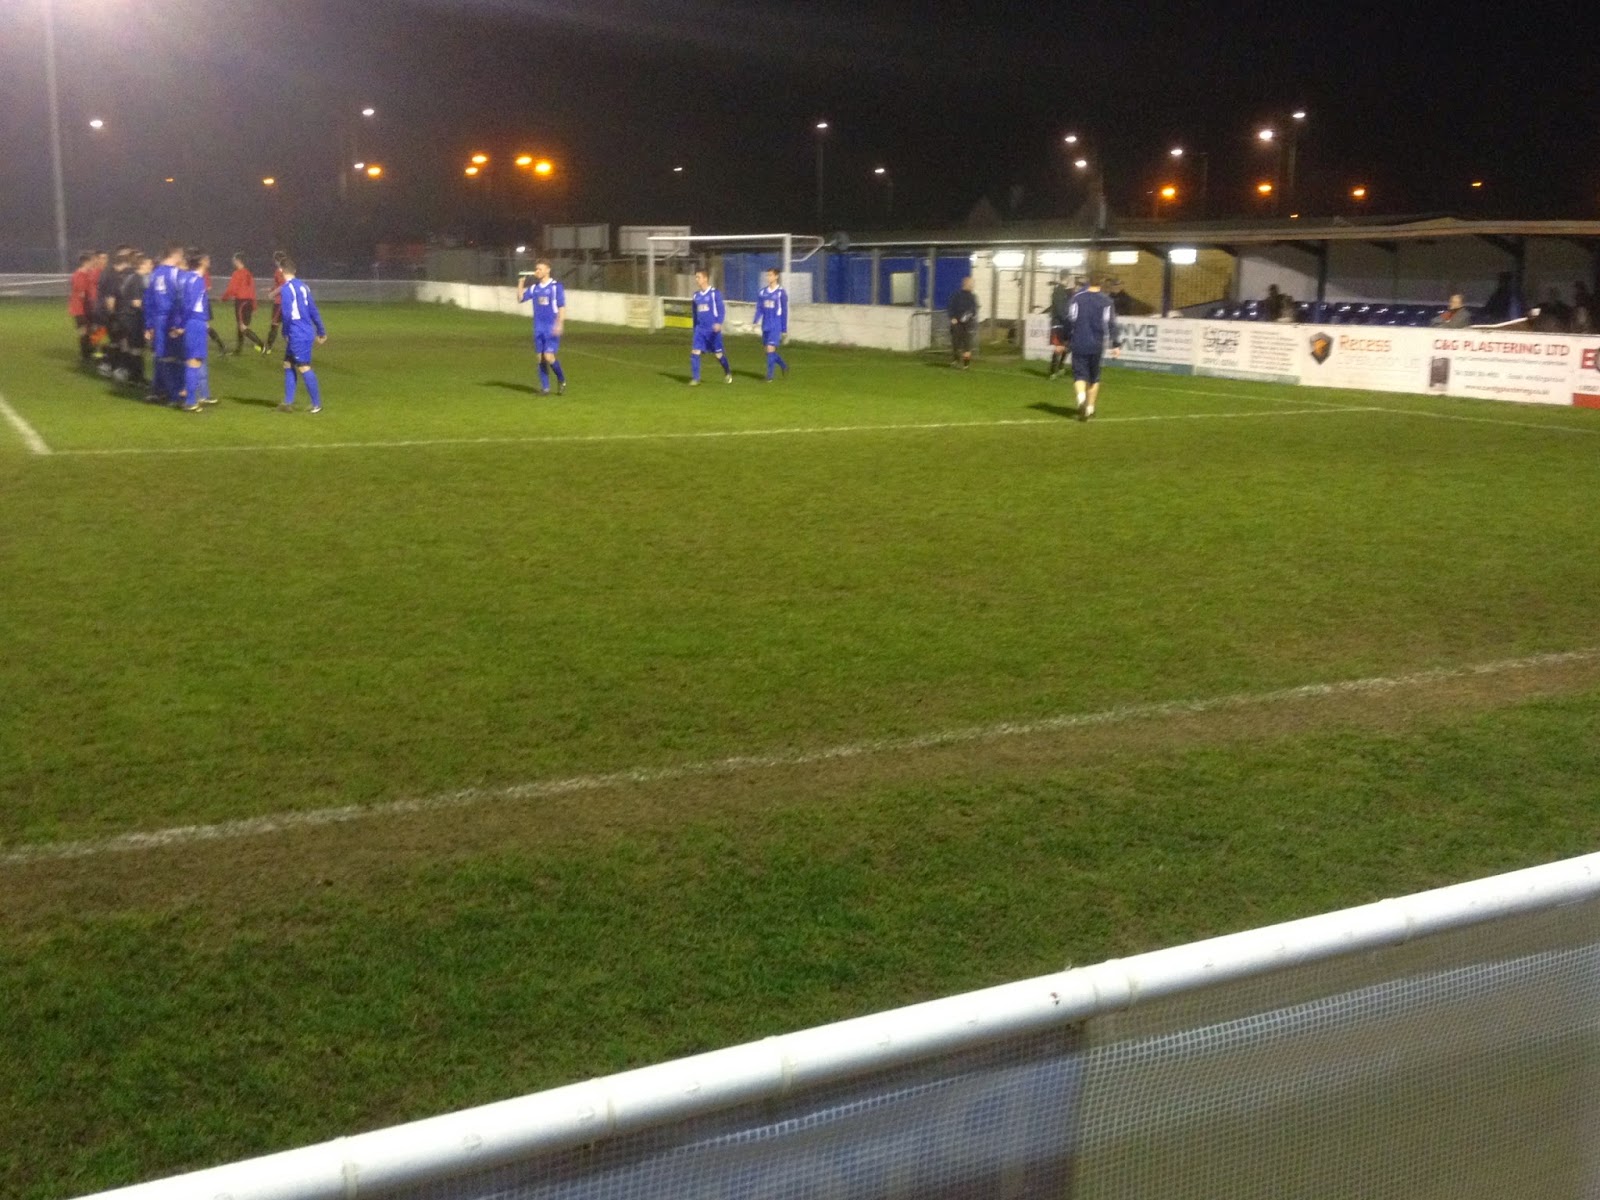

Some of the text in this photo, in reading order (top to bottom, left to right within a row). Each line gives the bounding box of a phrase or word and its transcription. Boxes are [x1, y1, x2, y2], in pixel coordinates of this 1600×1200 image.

[1339, 334, 1393, 352] Recess
[1433, 338, 1570, 356] C&G PLASTERING LTD
